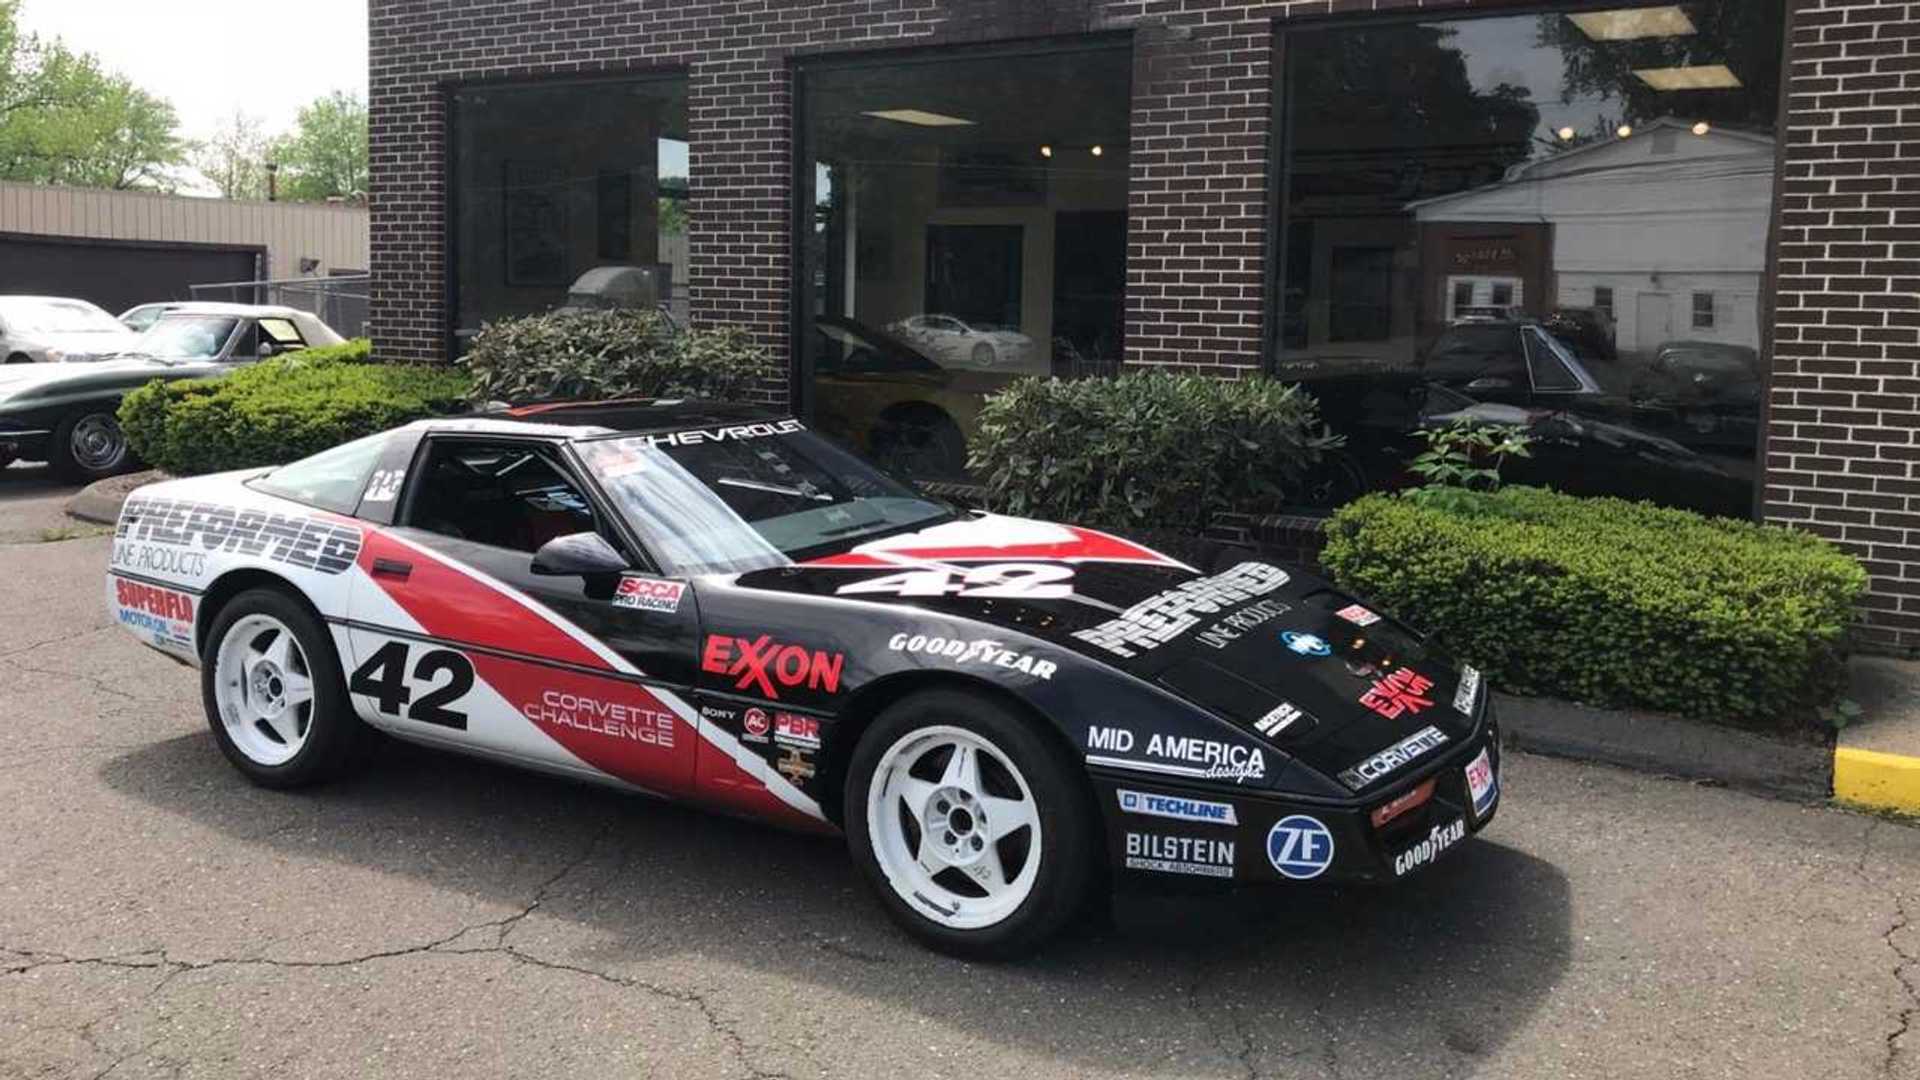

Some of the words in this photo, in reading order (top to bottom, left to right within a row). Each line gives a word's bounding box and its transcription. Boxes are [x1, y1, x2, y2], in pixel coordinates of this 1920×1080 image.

[115, 499, 364, 575] PREFORMED
[134, 545, 207, 577] PRODUCTS
[834, 563, 1076, 598] 42
[115, 578, 194, 624] SUPERFLO
[619, 578, 679, 599] SCCA
[1069, 562, 1291, 658] PREFORMED
[701, 634, 844, 700] EXXON
[888, 632, 1058, 680] GOODYEAR
[349, 639, 476, 732] 42
[1358, 666, 1435, 720] EXXON
[523, 703, 675, 748] CHALLENGE
[541, 690, 675, 731] CORVETTE
[701, 706, 736, 719] SONY
[747, 715, 765, 729] AC
[1087, 726, 1134, 751] MID
[1146, 734, 1265, 771] AMERICA
[1358, 729, 1447, 781] CORVETTE
[1144, 796, 1227, 819] TECHLINE
[1126, 833, 1236, 865] BILSTEIN
[1279, 829, 1321, 865] ZF
[1394, 818, 1466, 877] GOODYEAR
